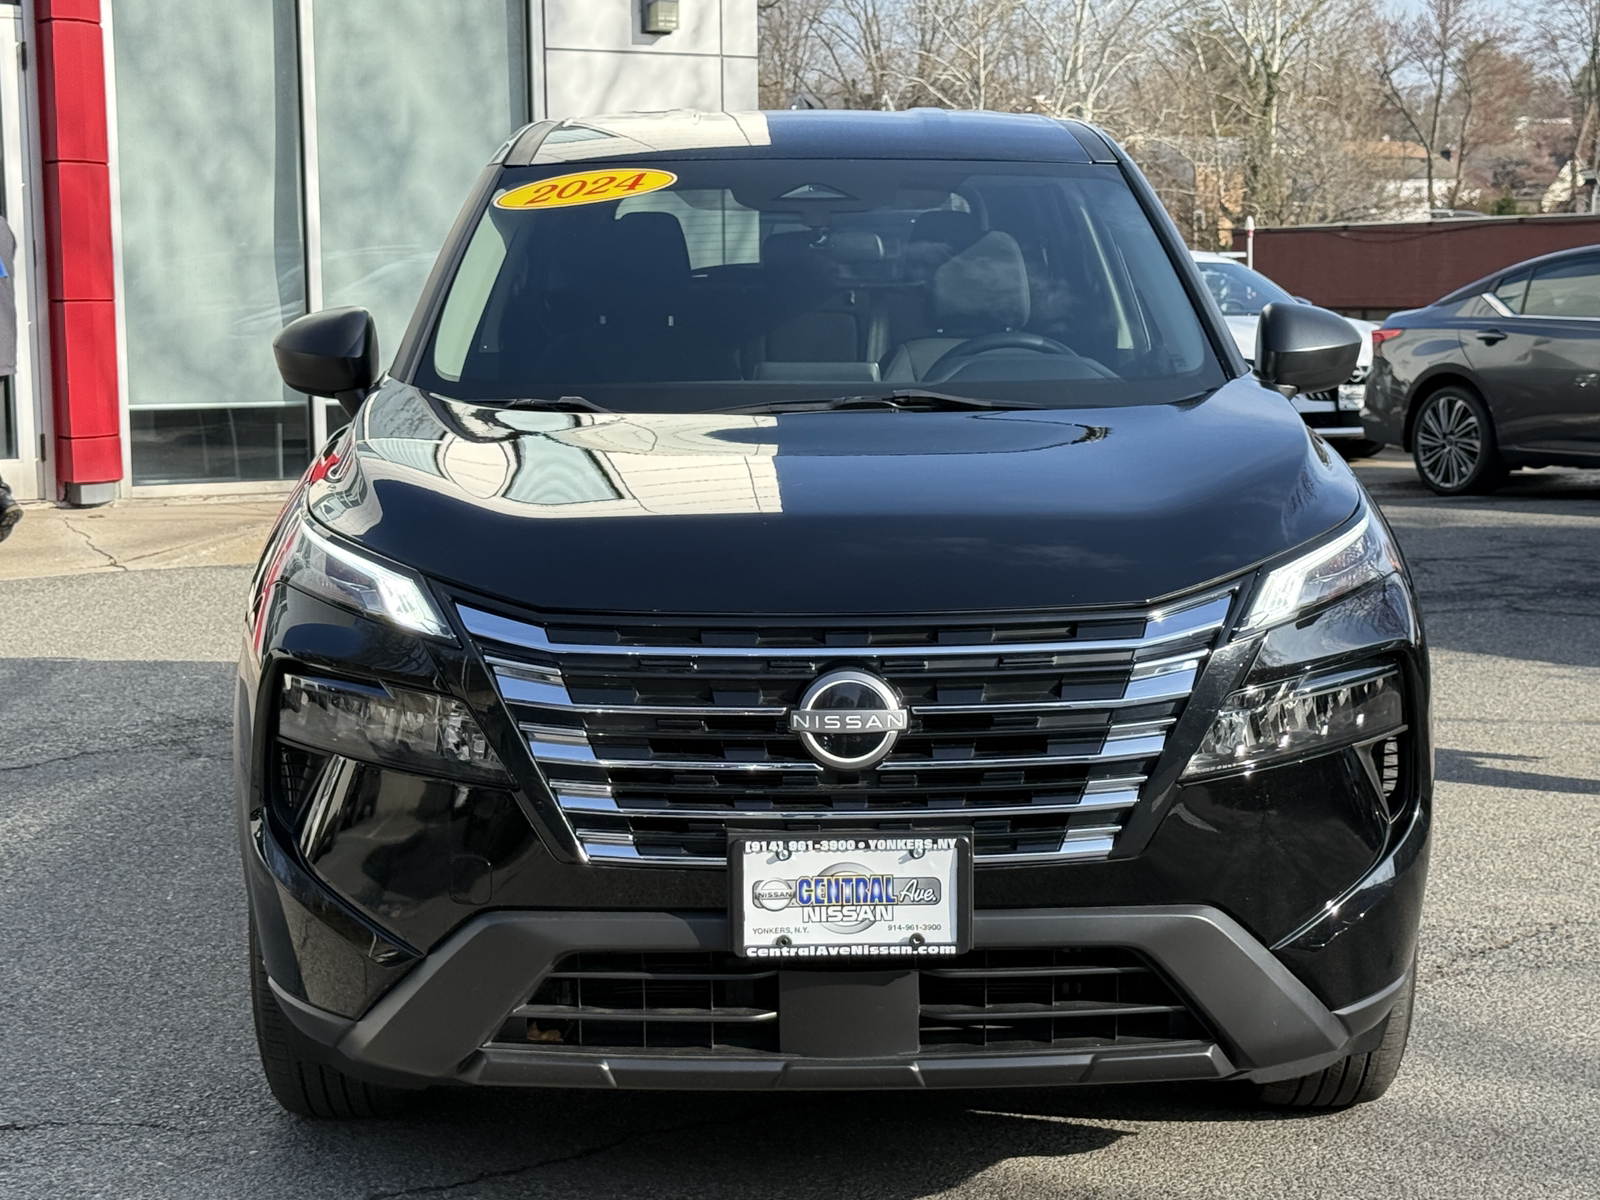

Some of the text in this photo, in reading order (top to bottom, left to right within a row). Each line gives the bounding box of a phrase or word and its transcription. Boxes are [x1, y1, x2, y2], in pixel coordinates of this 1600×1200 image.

[524, 173, 647, 205] 2024
[793, 714, 903, 729] NISSAN
[788, 839, 856, 851] 961-3900
[797, 874, 937, 906] CENTRAL Ave.
[802, 905, 894, 923] NISSAN
[752, 926, 809, 935] YONKERS, N.Y.
[887, 923, 942, 931] 914-961-3900
[746, 945, 957, 957] CentralAveNissan.com
